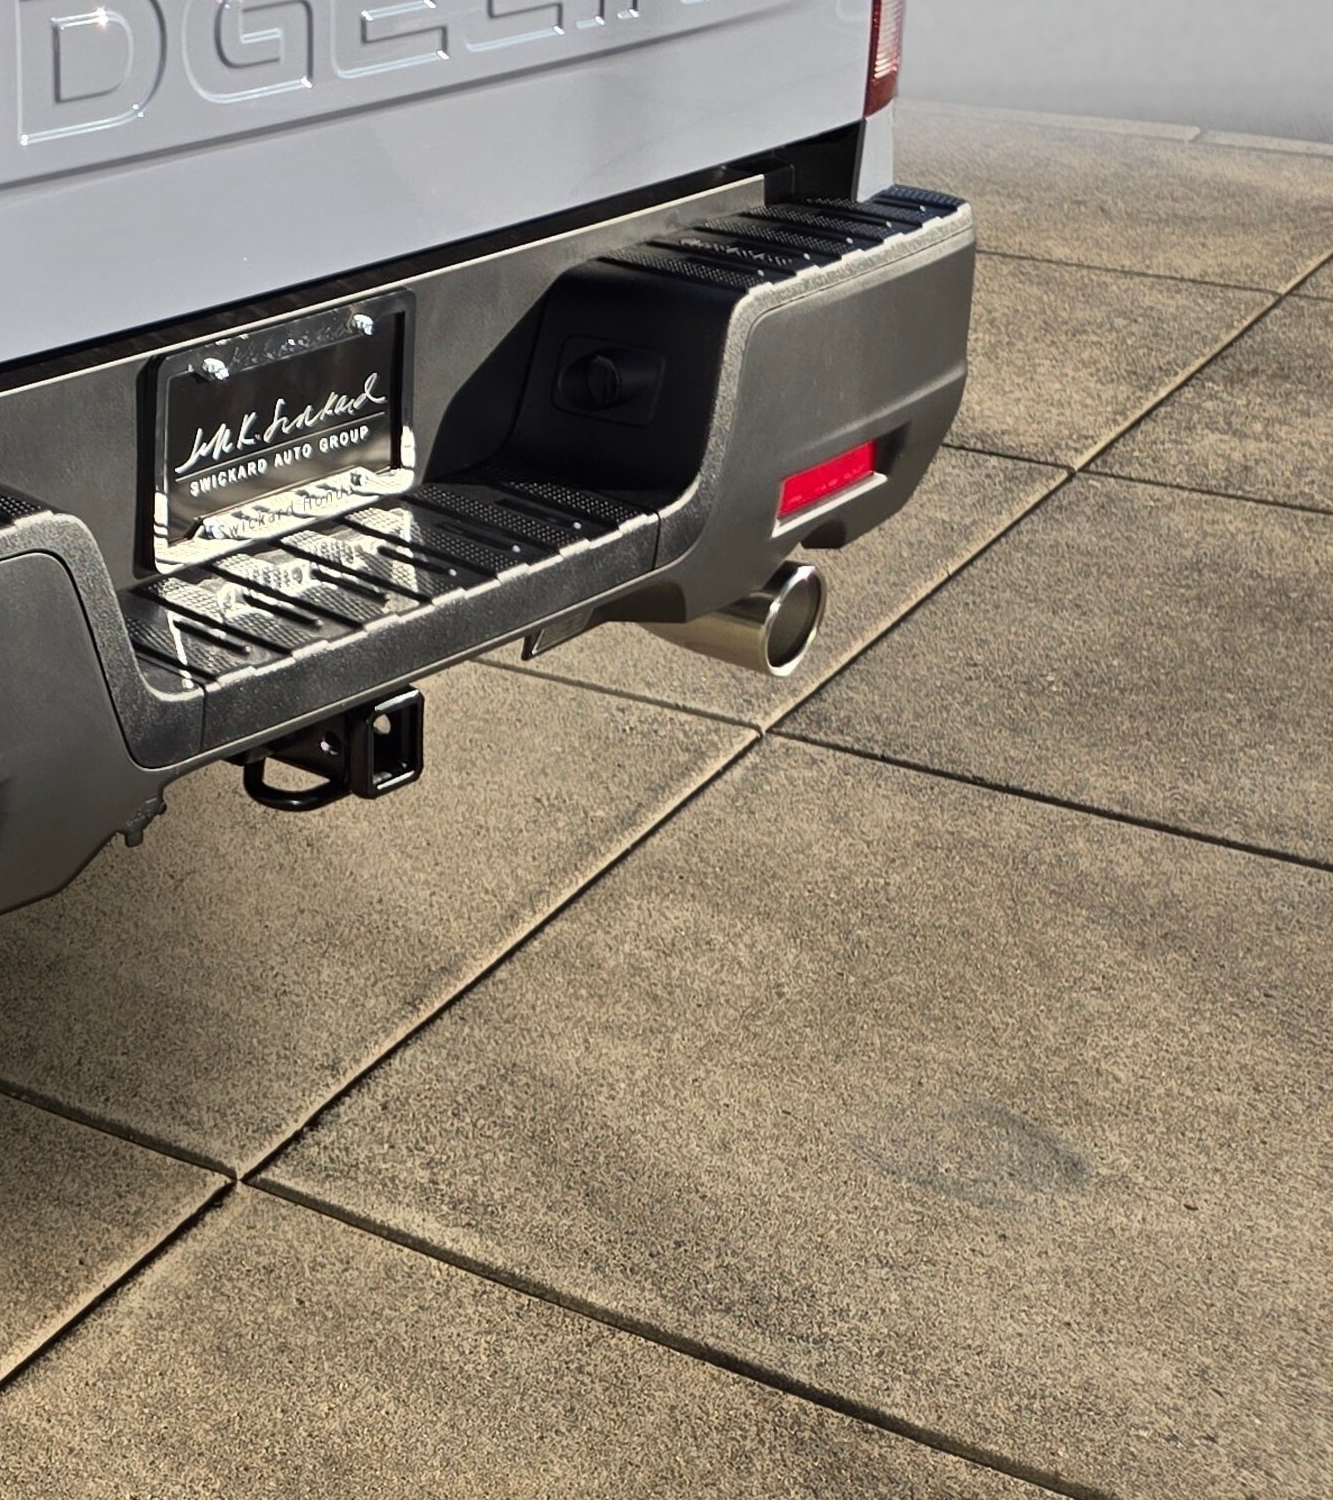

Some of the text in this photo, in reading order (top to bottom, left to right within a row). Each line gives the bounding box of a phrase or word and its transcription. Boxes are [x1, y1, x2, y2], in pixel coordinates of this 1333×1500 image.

[189, 424, 370, 498] SWICKARD AUTO GROUP
